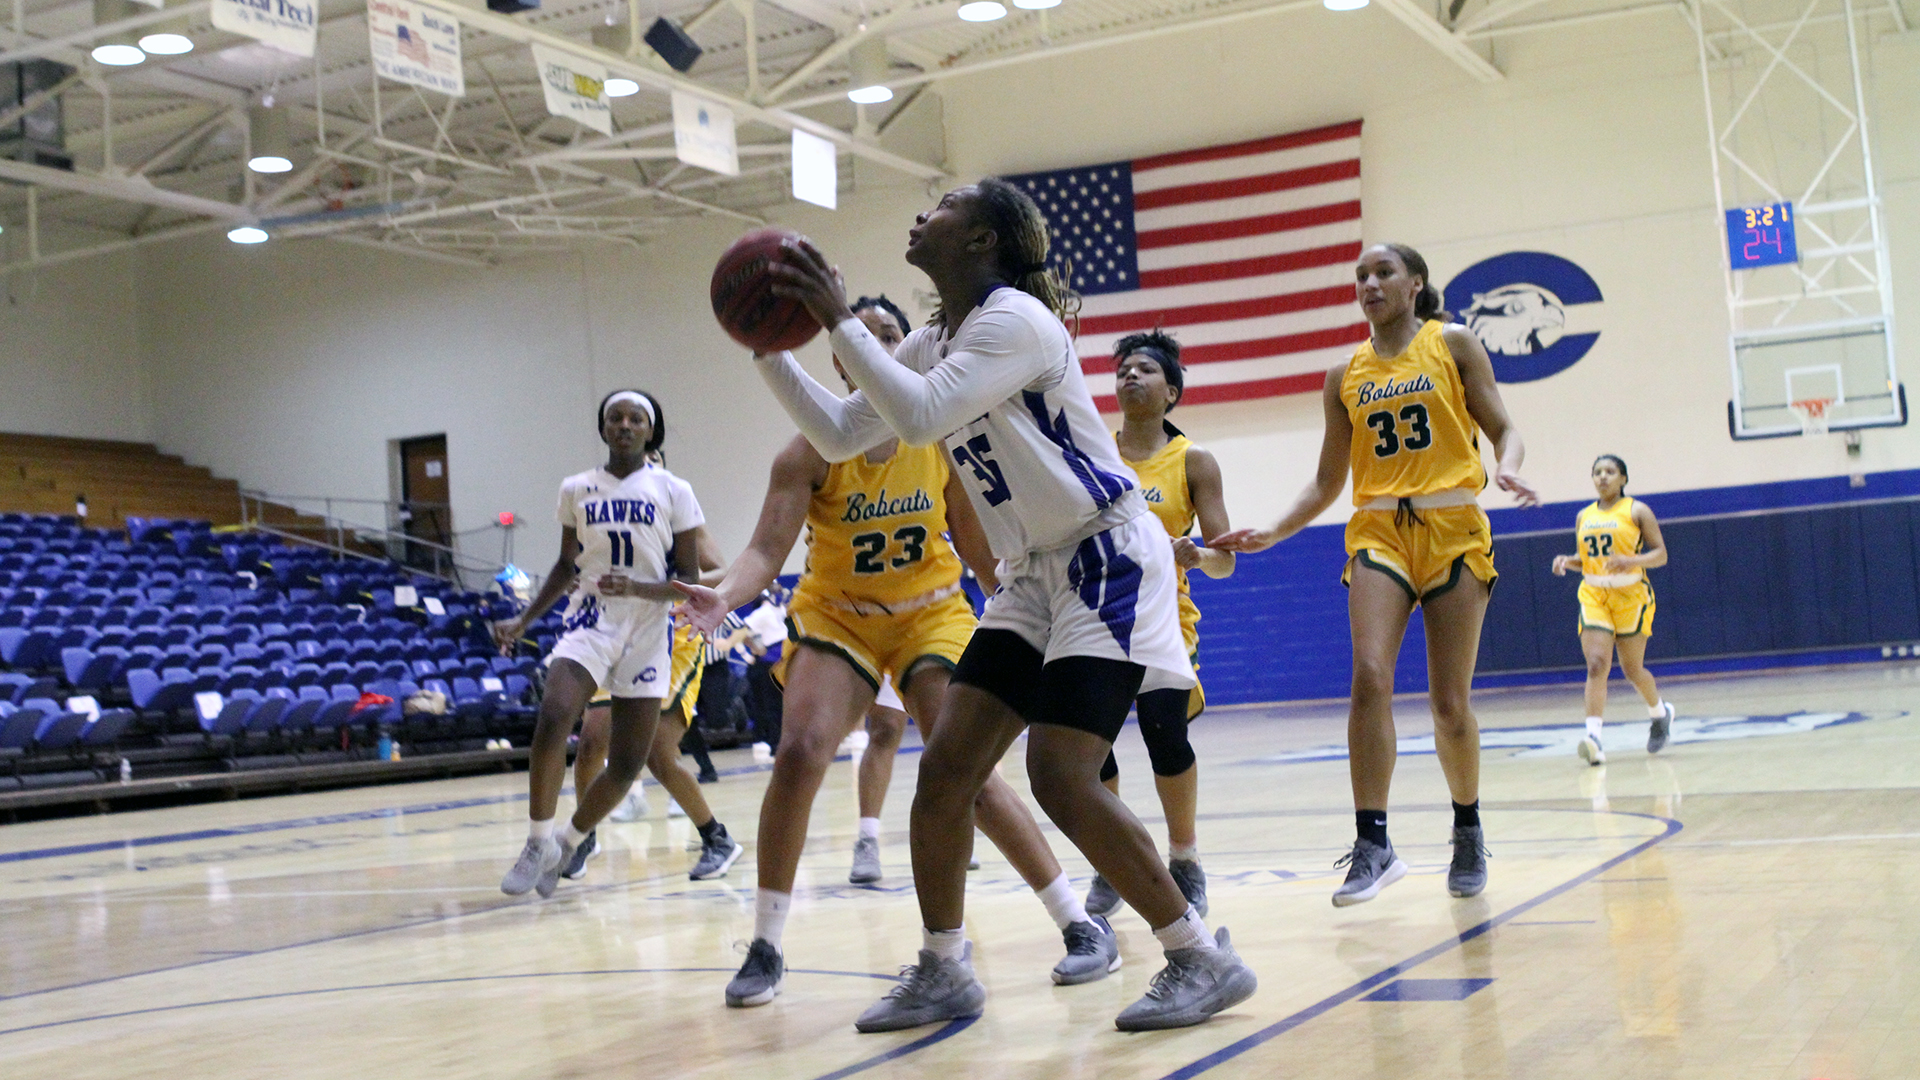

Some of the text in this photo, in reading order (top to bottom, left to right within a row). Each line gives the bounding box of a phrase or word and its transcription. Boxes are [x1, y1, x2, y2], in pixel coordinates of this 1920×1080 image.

[1745, 206, 1789, 229] 3:21
[1743, 228, 1783, 261] 24
[1356, 373, 1435, 408] Bobcats
[1366, 403, 1432, 458] 33
[952, 432, 1012, 508] 35
[585, 499, 655, 527] HAWKS
[840, 488, 934, 523] Bobcats
[607, 530, 634, 568] 11
[851, 525, 928, 574] 23
[1583, 532, 1614, 558] 32
